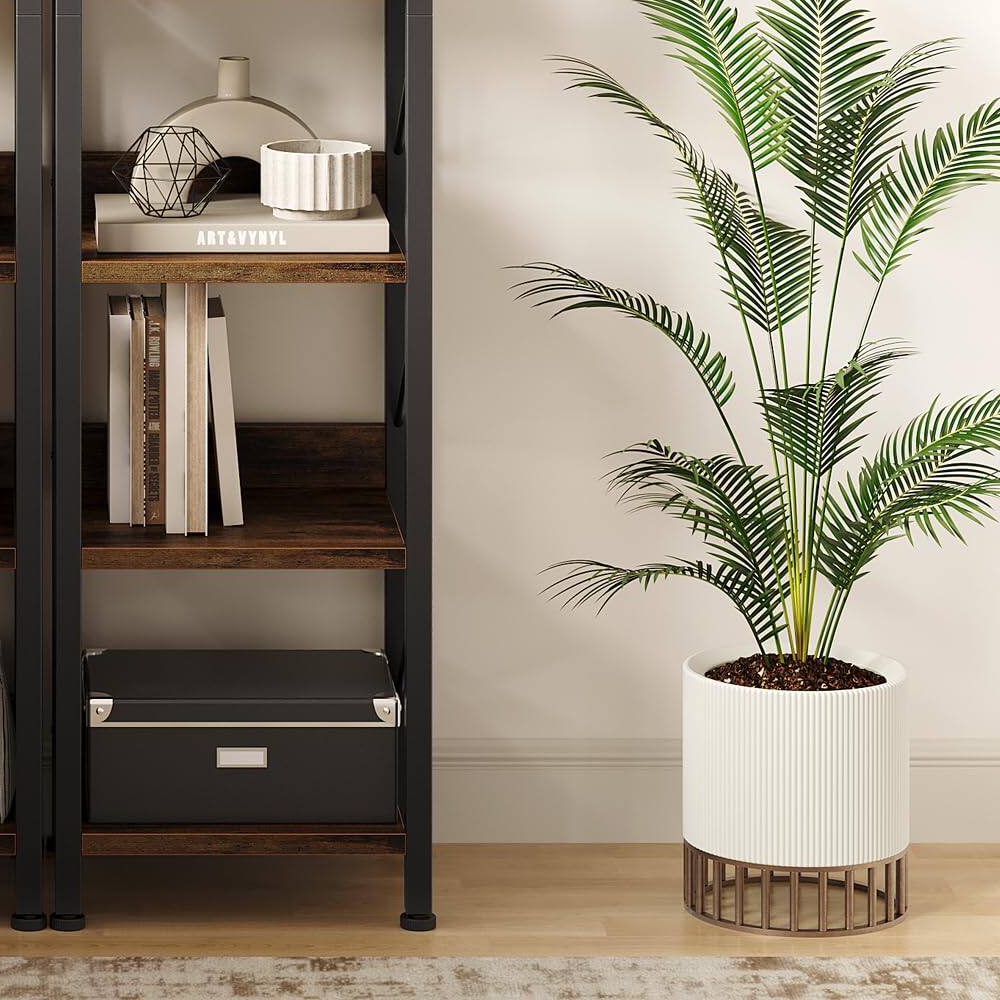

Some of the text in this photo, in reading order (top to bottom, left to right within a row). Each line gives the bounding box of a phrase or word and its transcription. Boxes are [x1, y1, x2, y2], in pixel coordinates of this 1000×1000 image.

[196, 230, 288, 246] ART&VYNYL
[149, 336, 160, 368] ROWLING
[149, 394, 160, 420] POTTER
